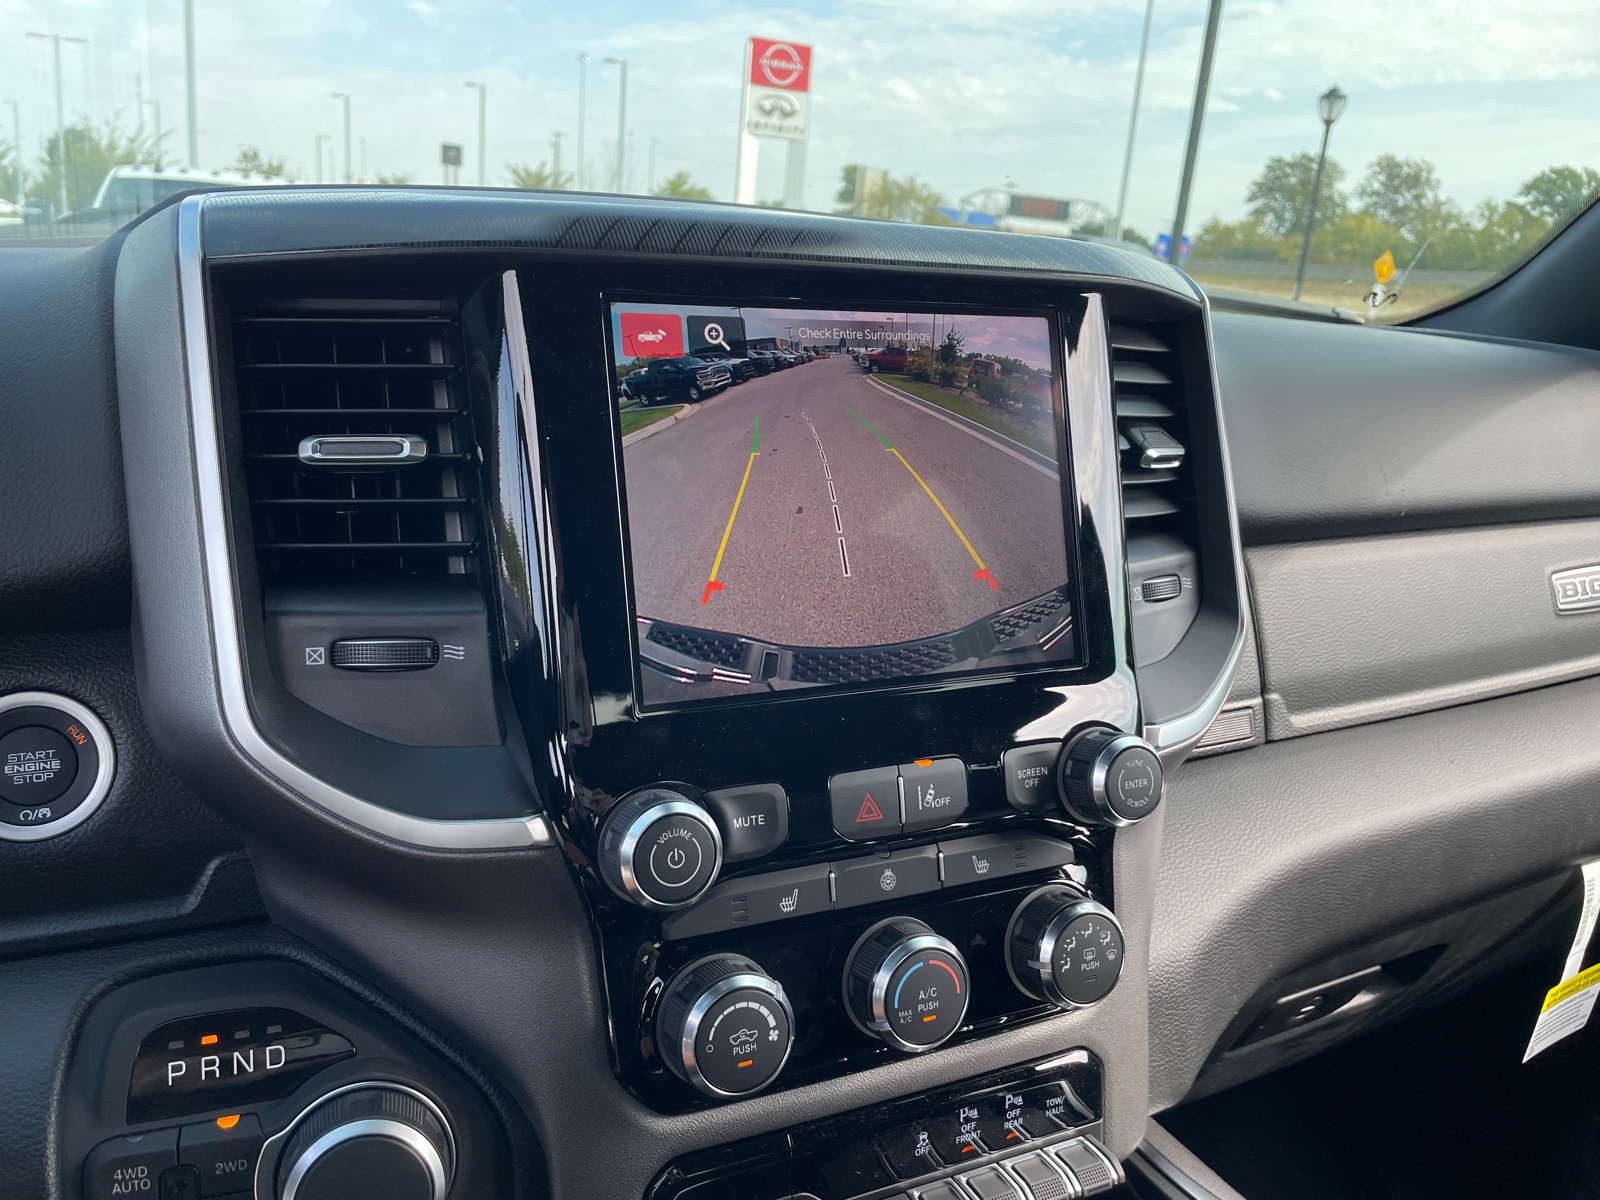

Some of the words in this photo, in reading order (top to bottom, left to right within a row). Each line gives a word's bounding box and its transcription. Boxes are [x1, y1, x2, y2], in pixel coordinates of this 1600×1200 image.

[798, 327, 832, 339] Check
[833, 327, 863, 340] Entire
[864, 328, 931, 343] Surroundings
[1555, 574, 1600, 603] BIG
[66, 724, 88, 746] RUN
[7, 749, 56, 763] START
[4, 760, 62, 774] ENGINE
[1126, 758, 1144, 768] TUNE
[13, 772, 54, 785] STOP
[1017, 766, 1048, 779] SCREEN
[1024, 777, 1040, 788] OFF
[1124, 778, 1148, 790] ENTER
[934, 796, 951, 808] OFF
[1126, 796, 1150, 808] SCROLL
[733, 814, 766, 830] MUTE
[656, 828, 693, 845] VOLUME
[1080, 960, 1100, 972] PUSH
[918, 986, 937, 1001] A/C
[917, 1000, 939, 1013] PUSH
[898, 1009, 913, 1018] MAX
[899, 1015, 913, 1025] A/C
[733, 1043, 757, 1057] PUSH
[1006, 1108, 1021, 1120] OFF
[1045, 1105, 1066, 1117] HAUL
[961, 1121, 977, 1133] OFF
[1003, 1117, 1024, 1130] REAR
[955, 1130, 981, 1145] FRONT
[914, 1145, 931, 1157] OFF
[214, 1158, 248, 1175] 2WD
[113, 1166, 148, 1182] 4WD
[112, 1178, 152, 1195] AUTO
